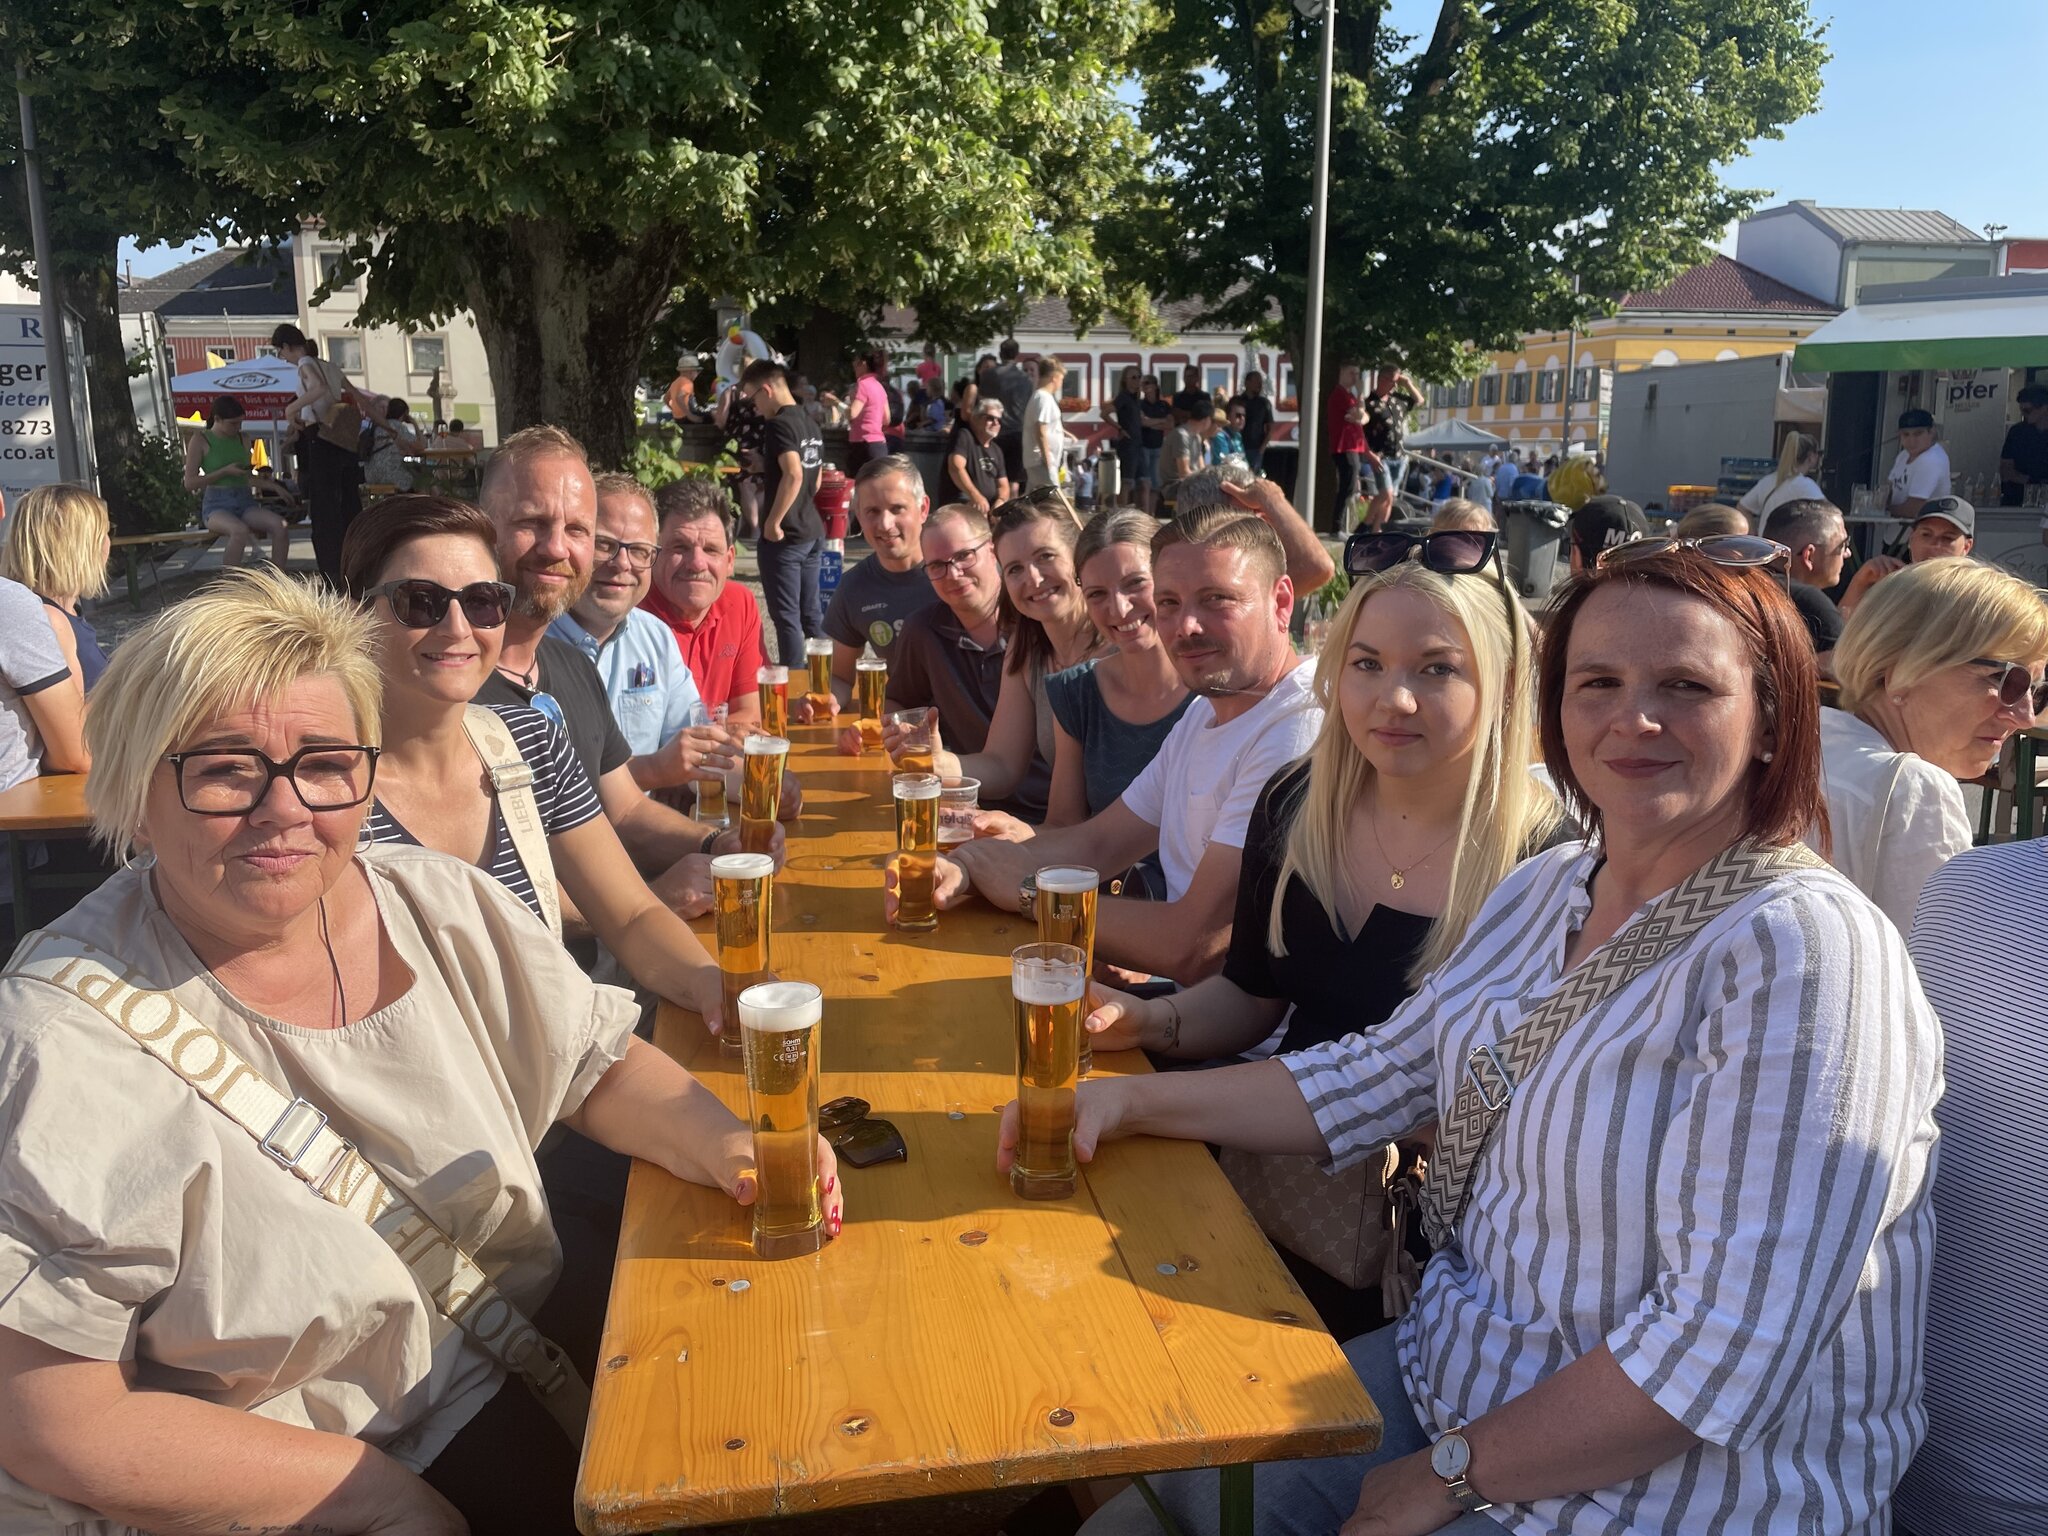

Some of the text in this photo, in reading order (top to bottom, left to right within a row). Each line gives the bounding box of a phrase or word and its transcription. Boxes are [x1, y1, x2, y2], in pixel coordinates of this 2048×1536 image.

[20, 317, 43, 338] R
[0, 363, 47, 387] ger
[0, 391, 49, 407] ieten
[1, 420, 52, 435] 8273
[51, 944, 263, 1103] JOOP!
